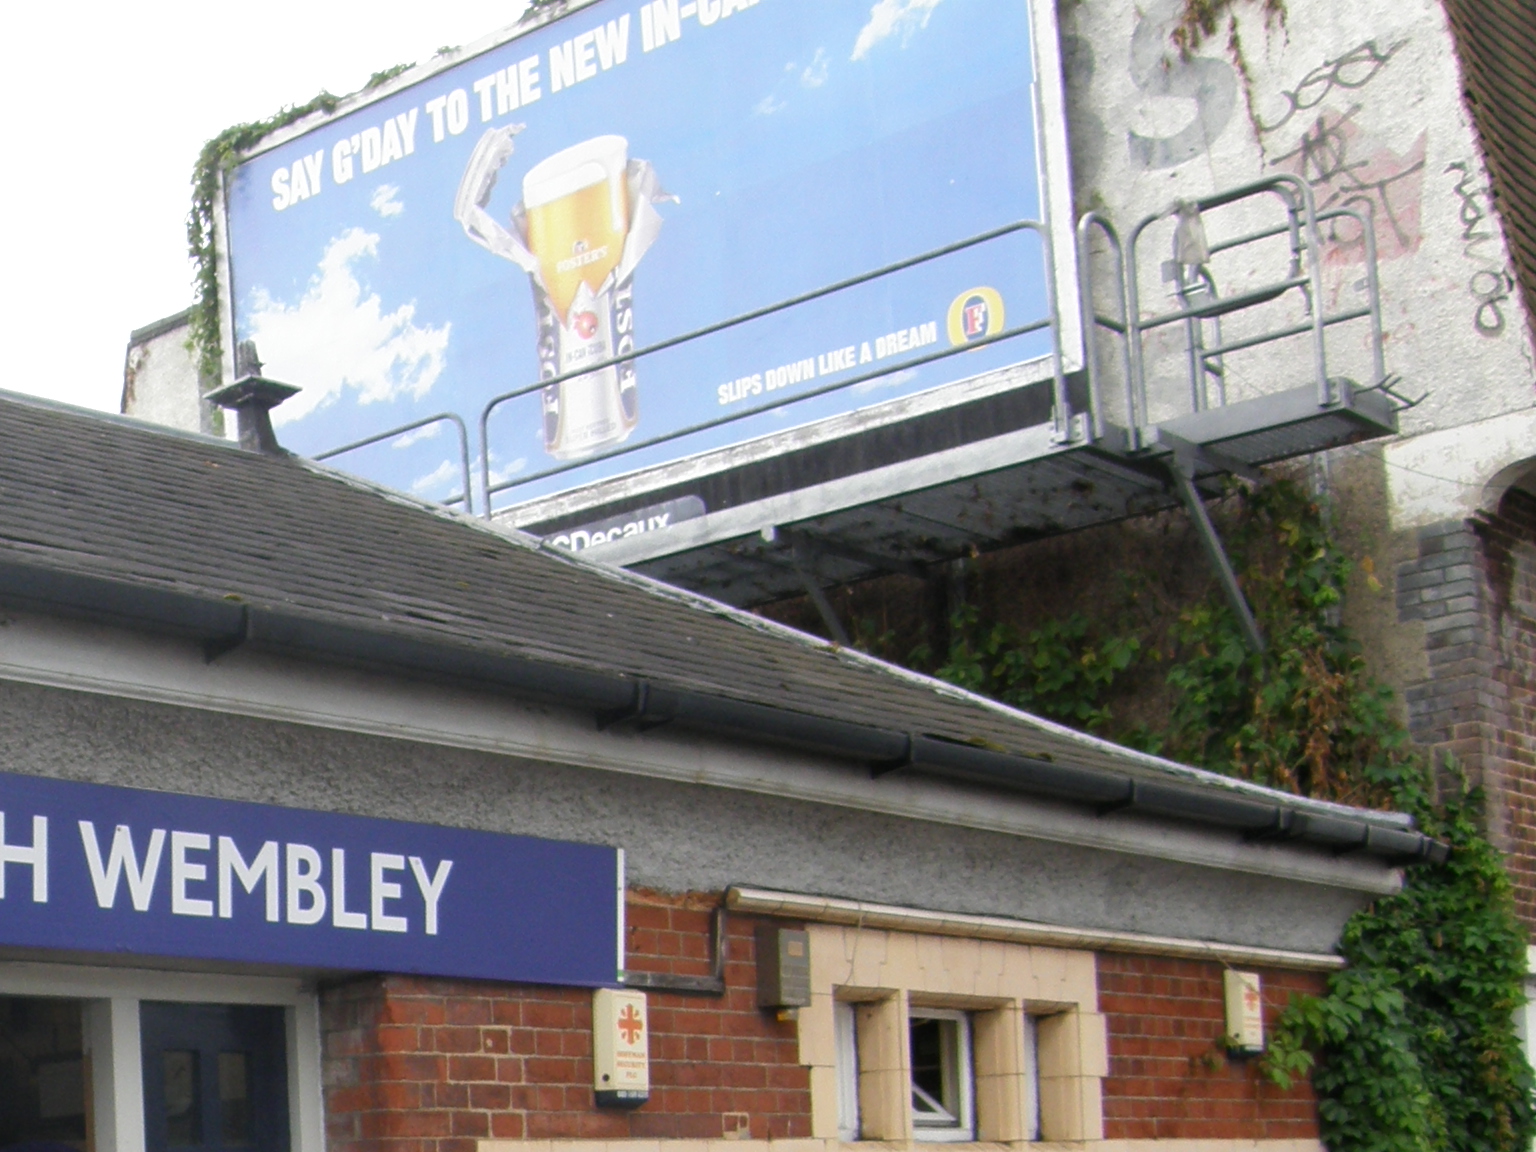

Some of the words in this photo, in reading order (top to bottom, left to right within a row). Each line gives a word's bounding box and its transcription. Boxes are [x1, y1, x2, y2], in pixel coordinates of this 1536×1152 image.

[271, 149, 324, 211] SAY
[332, 107, 418, 185] G'DAY
[425, 88, 469, 143] TO
[473, 54, 541, 122] THE
[549, 13, 630, 93] NEW
[717, 373, 763, 405] SLIPS
[765, 360, 815, 392] DOWN
[818, 345, 856, 376] LIKE
[859, 341, 872, 364] A
[876, 321, 938, 360] DREAM
[548, 513, 670, 551] CDecaux
[78, 820, 453, 935] WEMBLEY
